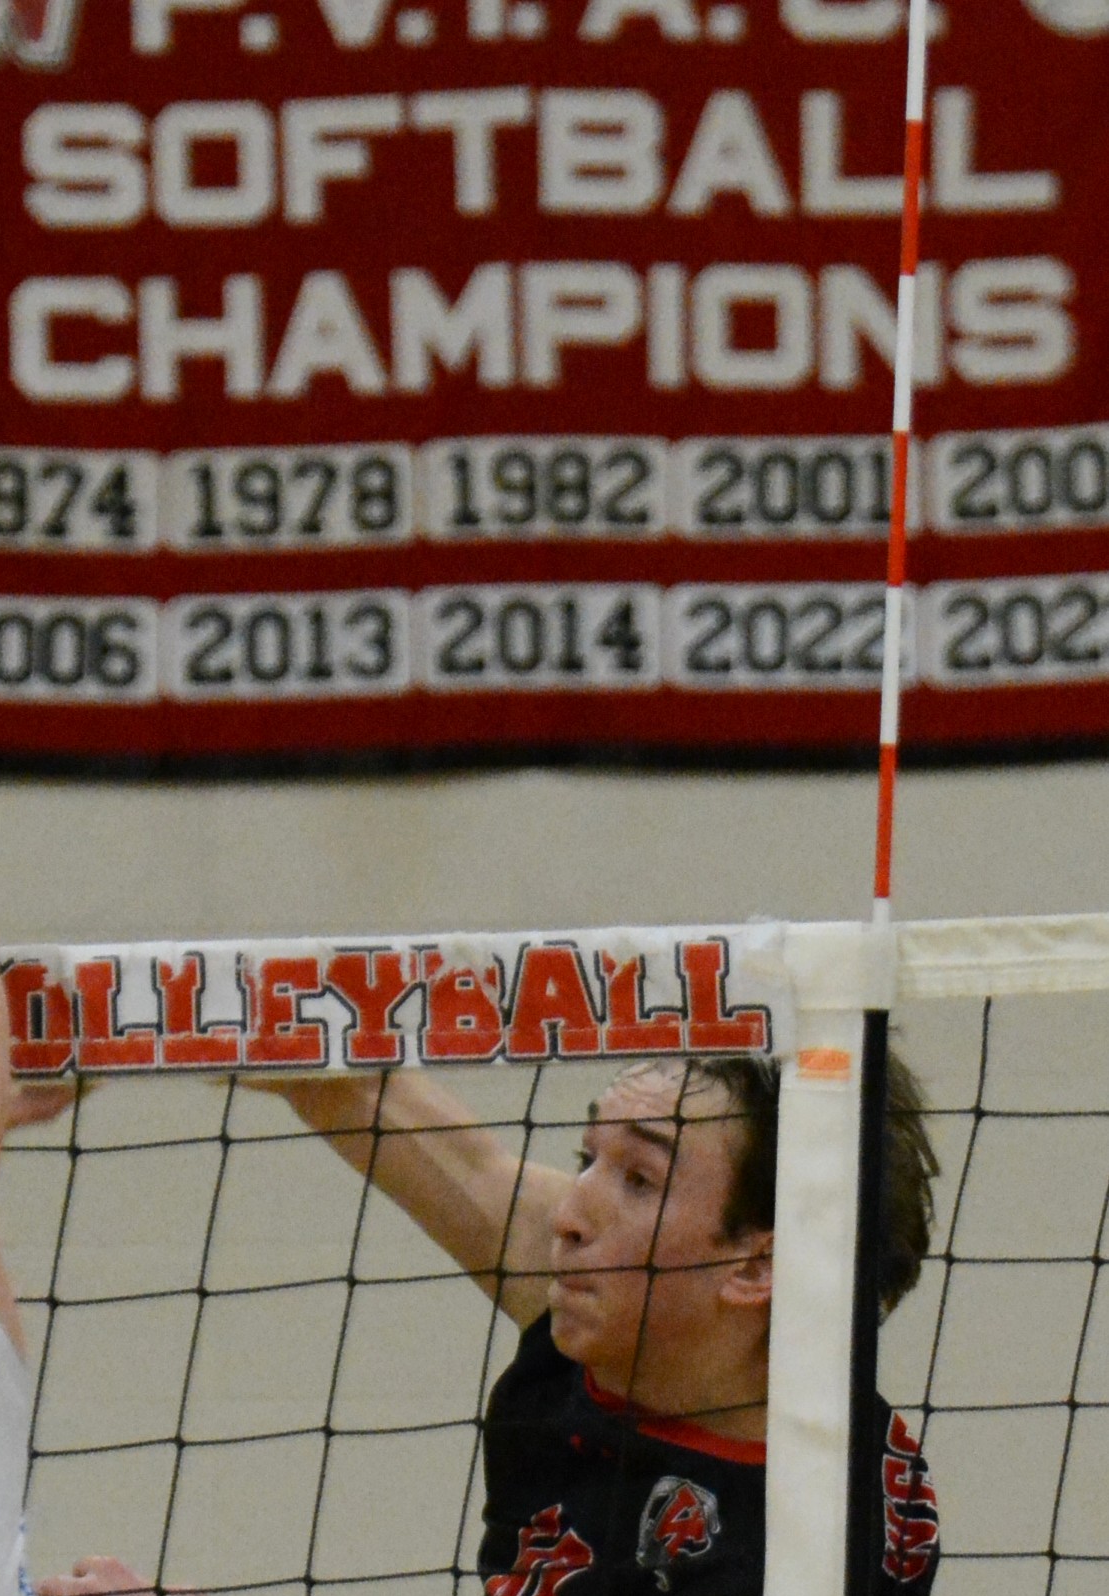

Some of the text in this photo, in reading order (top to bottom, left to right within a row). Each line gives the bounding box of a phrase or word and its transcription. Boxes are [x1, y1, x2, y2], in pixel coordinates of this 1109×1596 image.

[23, 88, 1058, 228] SOFTBALL
[9, 256, 1075, 402] CHAMPIONS
[189, 455, 401, 540] 1978
[449, 446, 655, 528] 1982
[695, 448, 893, 528] 2001
[185, 602, 395, 686] 2013
[435, 598, 645, 678] 2014
[684, 600, 903, 676] 2022
